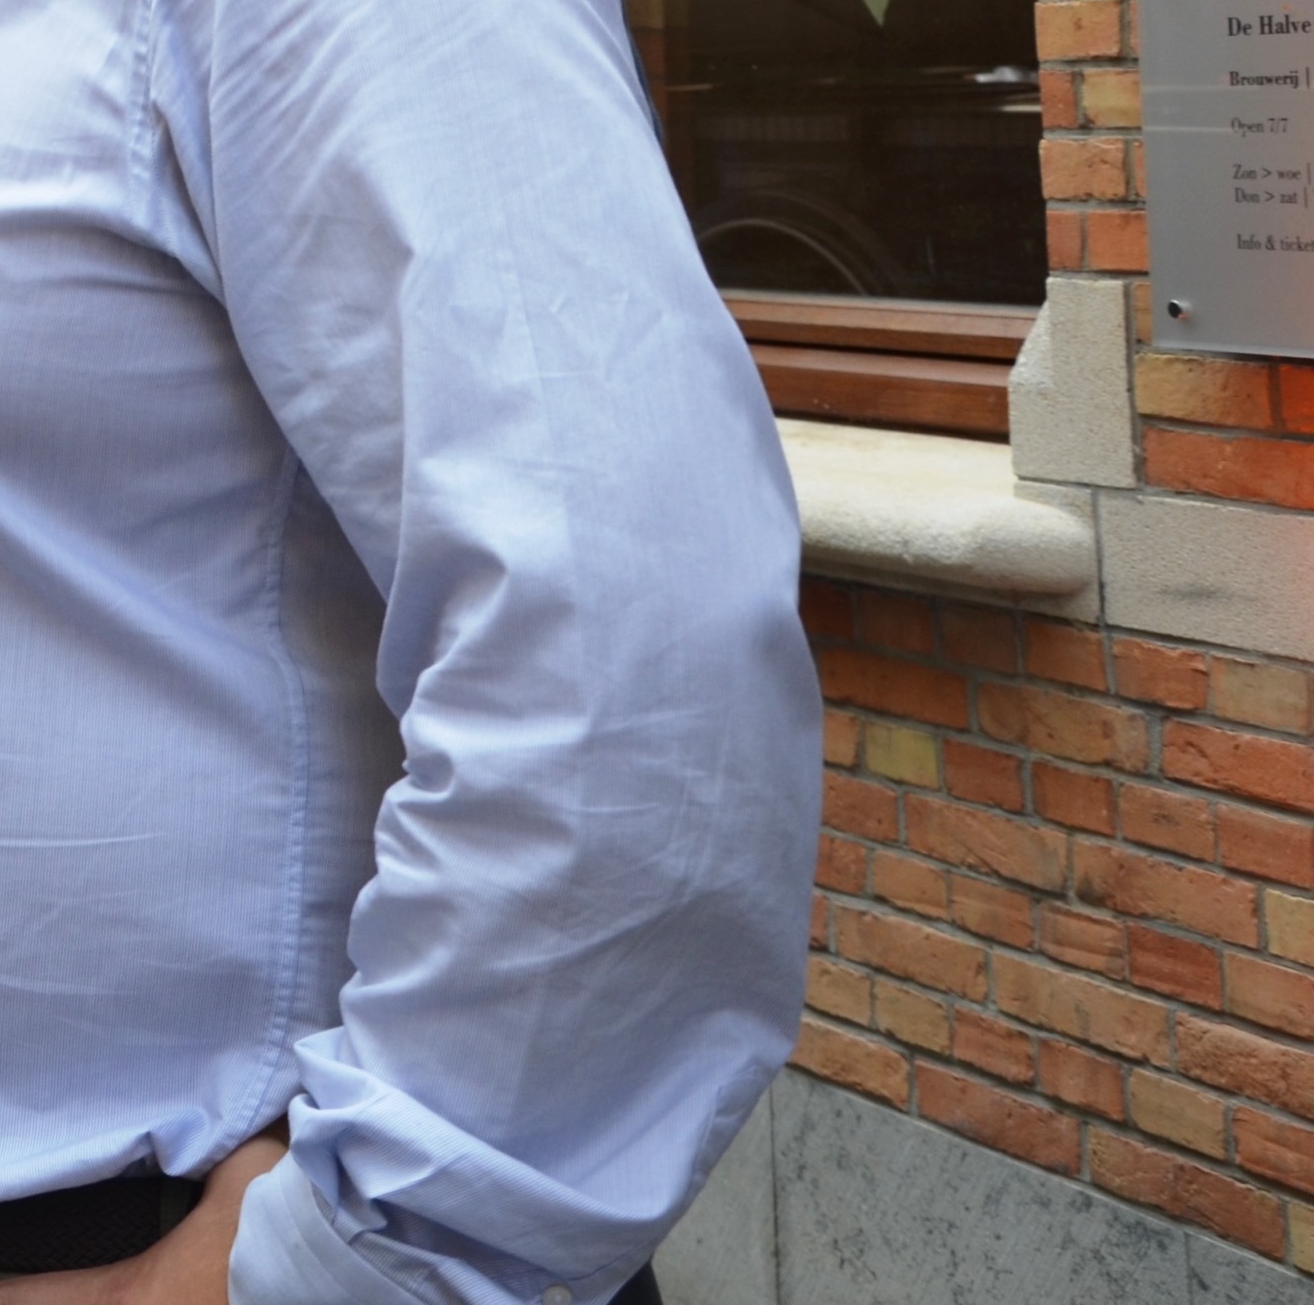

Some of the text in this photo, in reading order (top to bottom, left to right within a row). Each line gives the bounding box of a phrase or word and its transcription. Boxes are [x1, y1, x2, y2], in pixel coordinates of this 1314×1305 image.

[1228, 14, 1312, 36] De Halve
[1229, 70, 1299, 89] Brouwerij
[1230, 117, 1289, 138] Open 7/7
[1233, 164, 1257, 180] Zon
[1234, 187, 1260, 203] Don
[1236, 233, 1262, 250] Info
